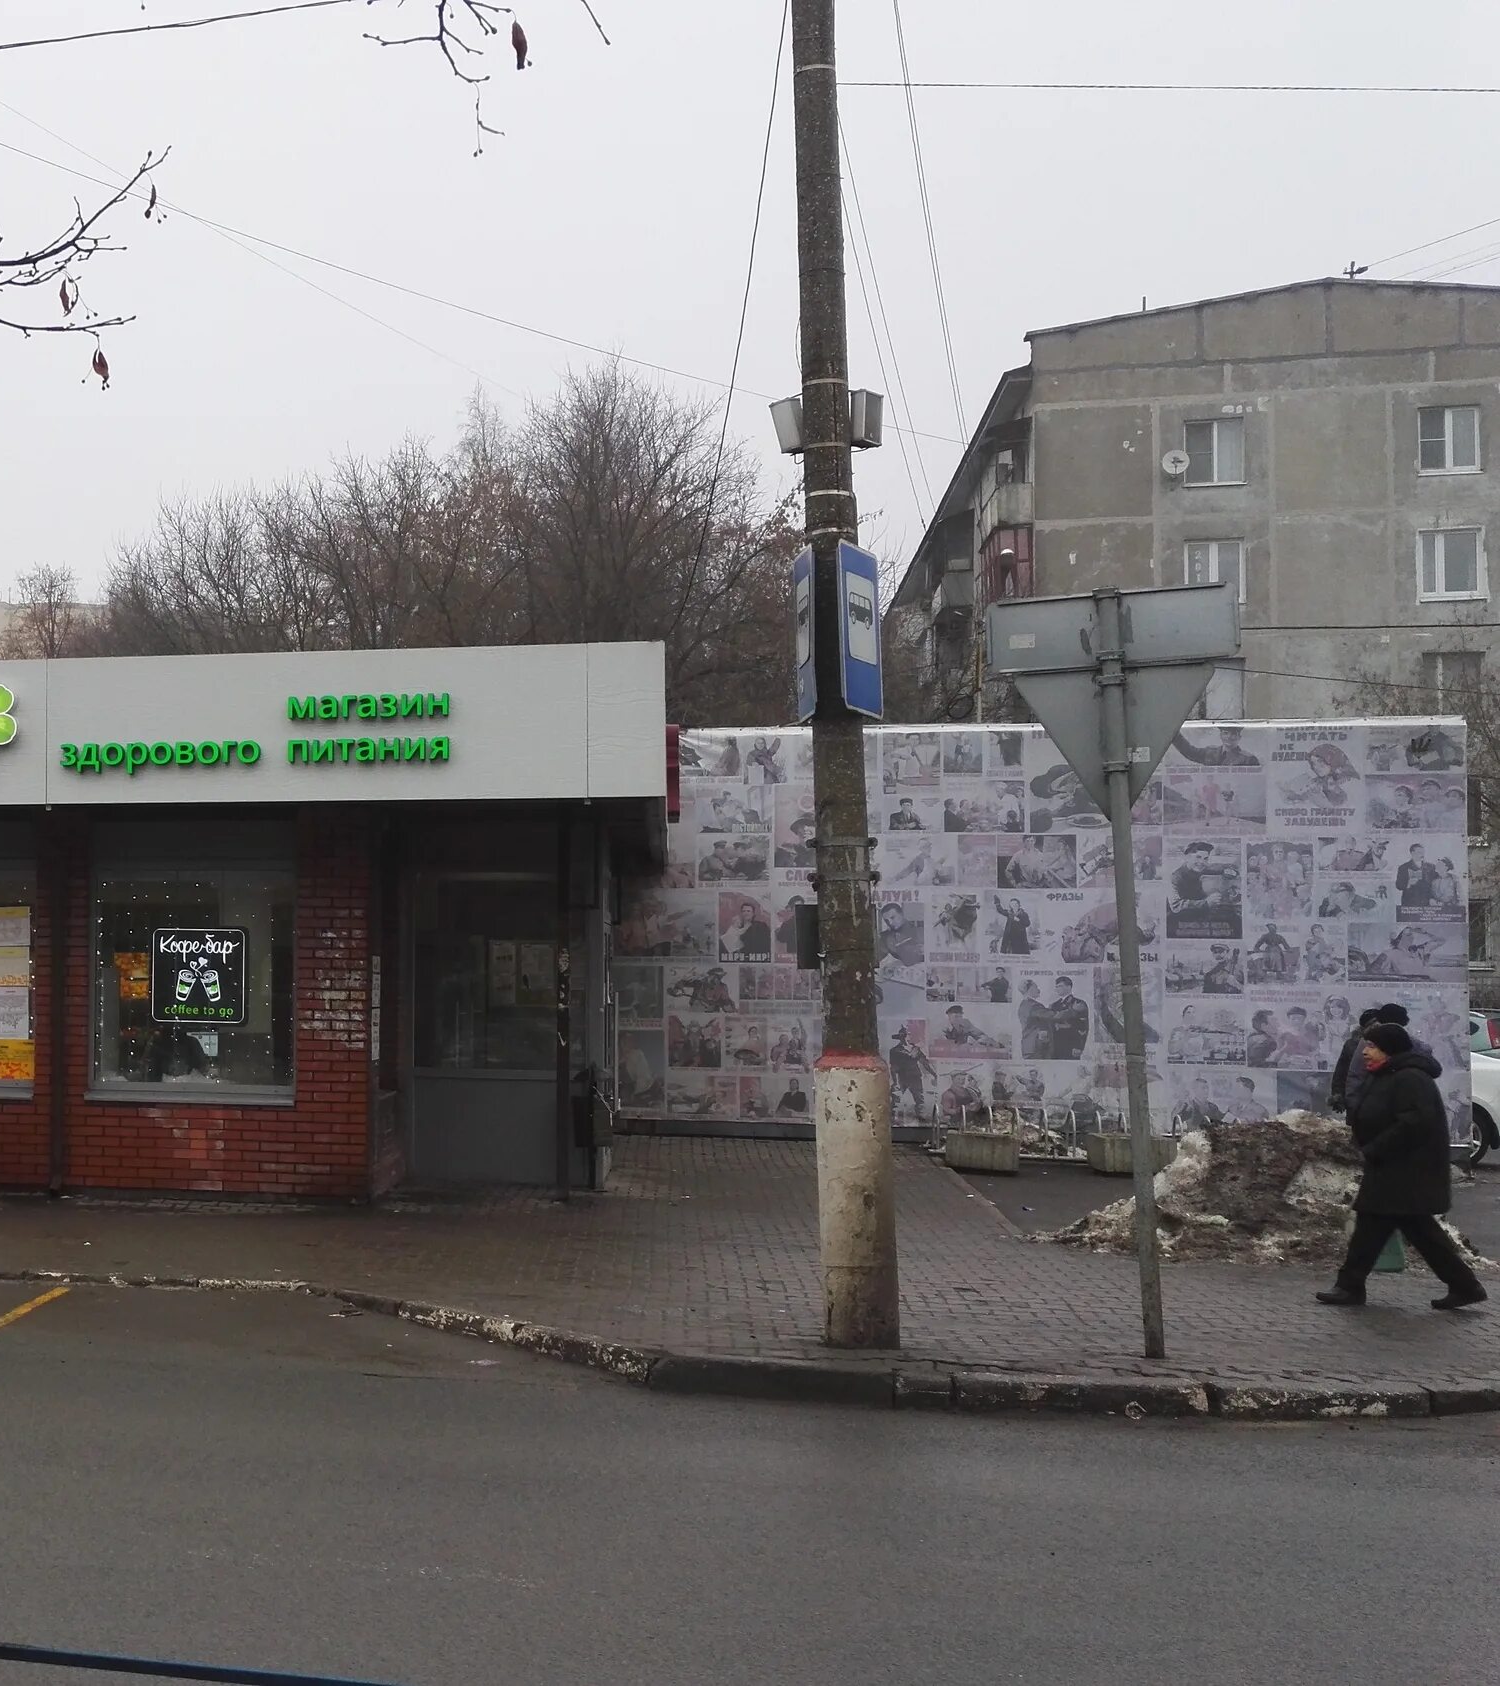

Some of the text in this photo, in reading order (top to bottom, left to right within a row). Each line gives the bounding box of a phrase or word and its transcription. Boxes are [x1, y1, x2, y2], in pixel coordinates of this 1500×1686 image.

[287, 692, 451, 720] магазин
[1284, 731, 1348, 741] ЧИТАТЬ
[60, 735, 451, 774] здорового питания
[1046, 892, 1084, 902] ФРАЗЫ
[164, 1004, 234, 1018] coffee to go
